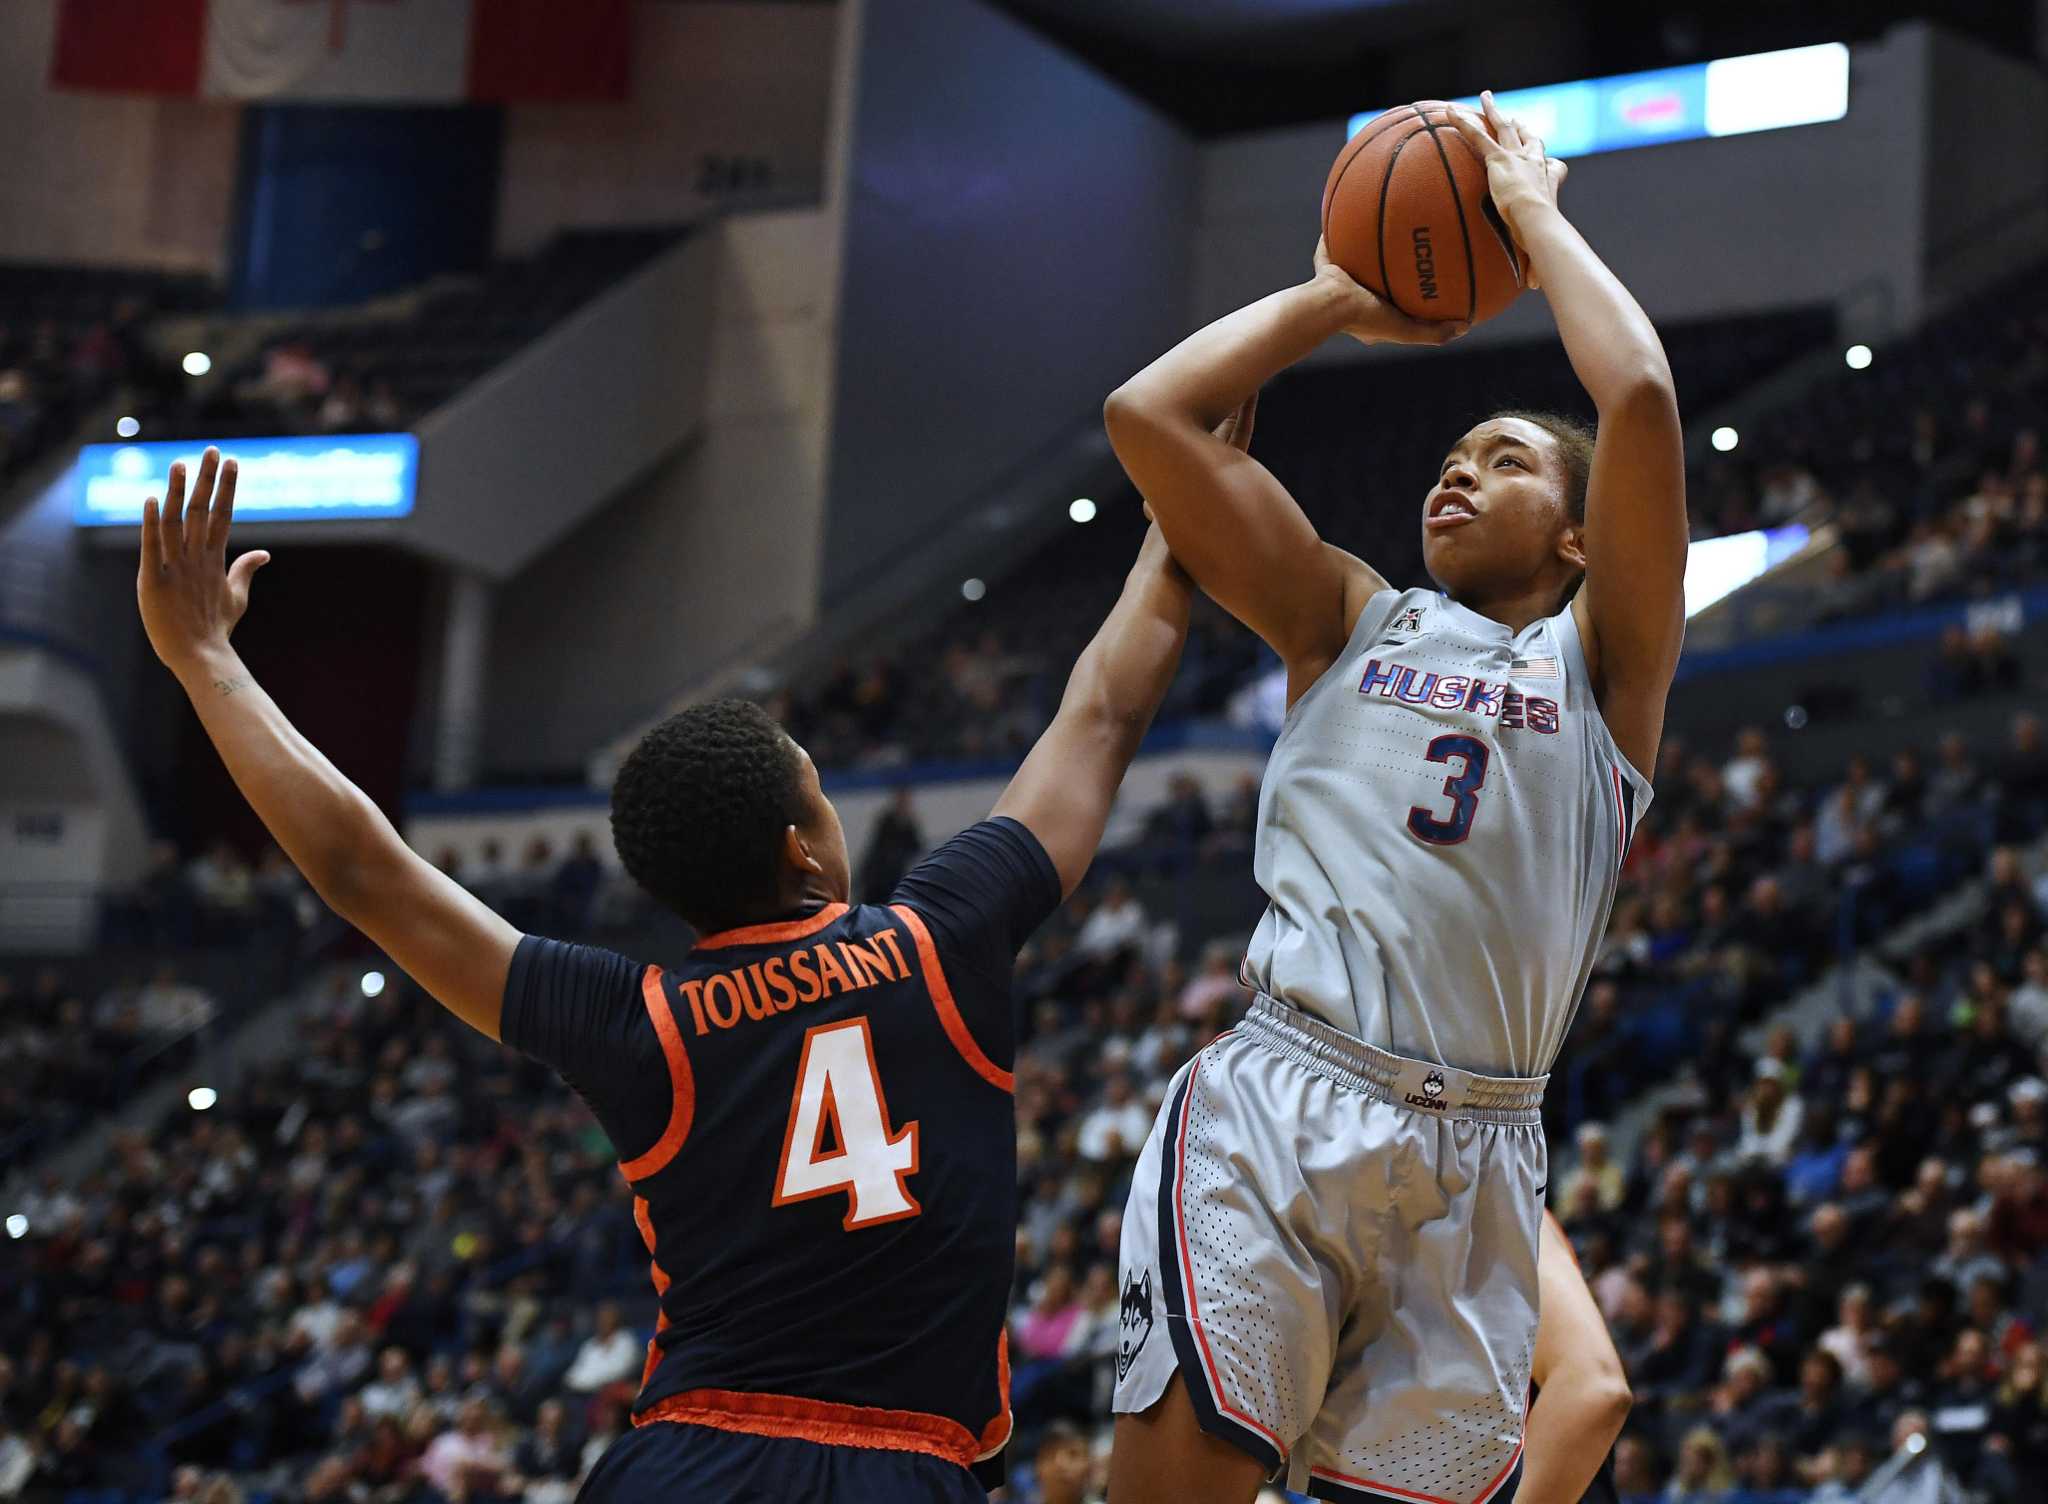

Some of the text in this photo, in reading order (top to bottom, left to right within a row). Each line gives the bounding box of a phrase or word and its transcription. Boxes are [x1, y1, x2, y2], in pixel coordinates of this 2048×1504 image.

[1412, 225, 1439, 299] UCONN
[1358, 659, 1560, 735] HUSKES
[1407, 734, 1490, 845] 3
[680, 928, 912, 1036] TOUSSAINT
[772, 1016, 922, 1232] 4
[1404, 1092, 1448, 1111] UCONN
